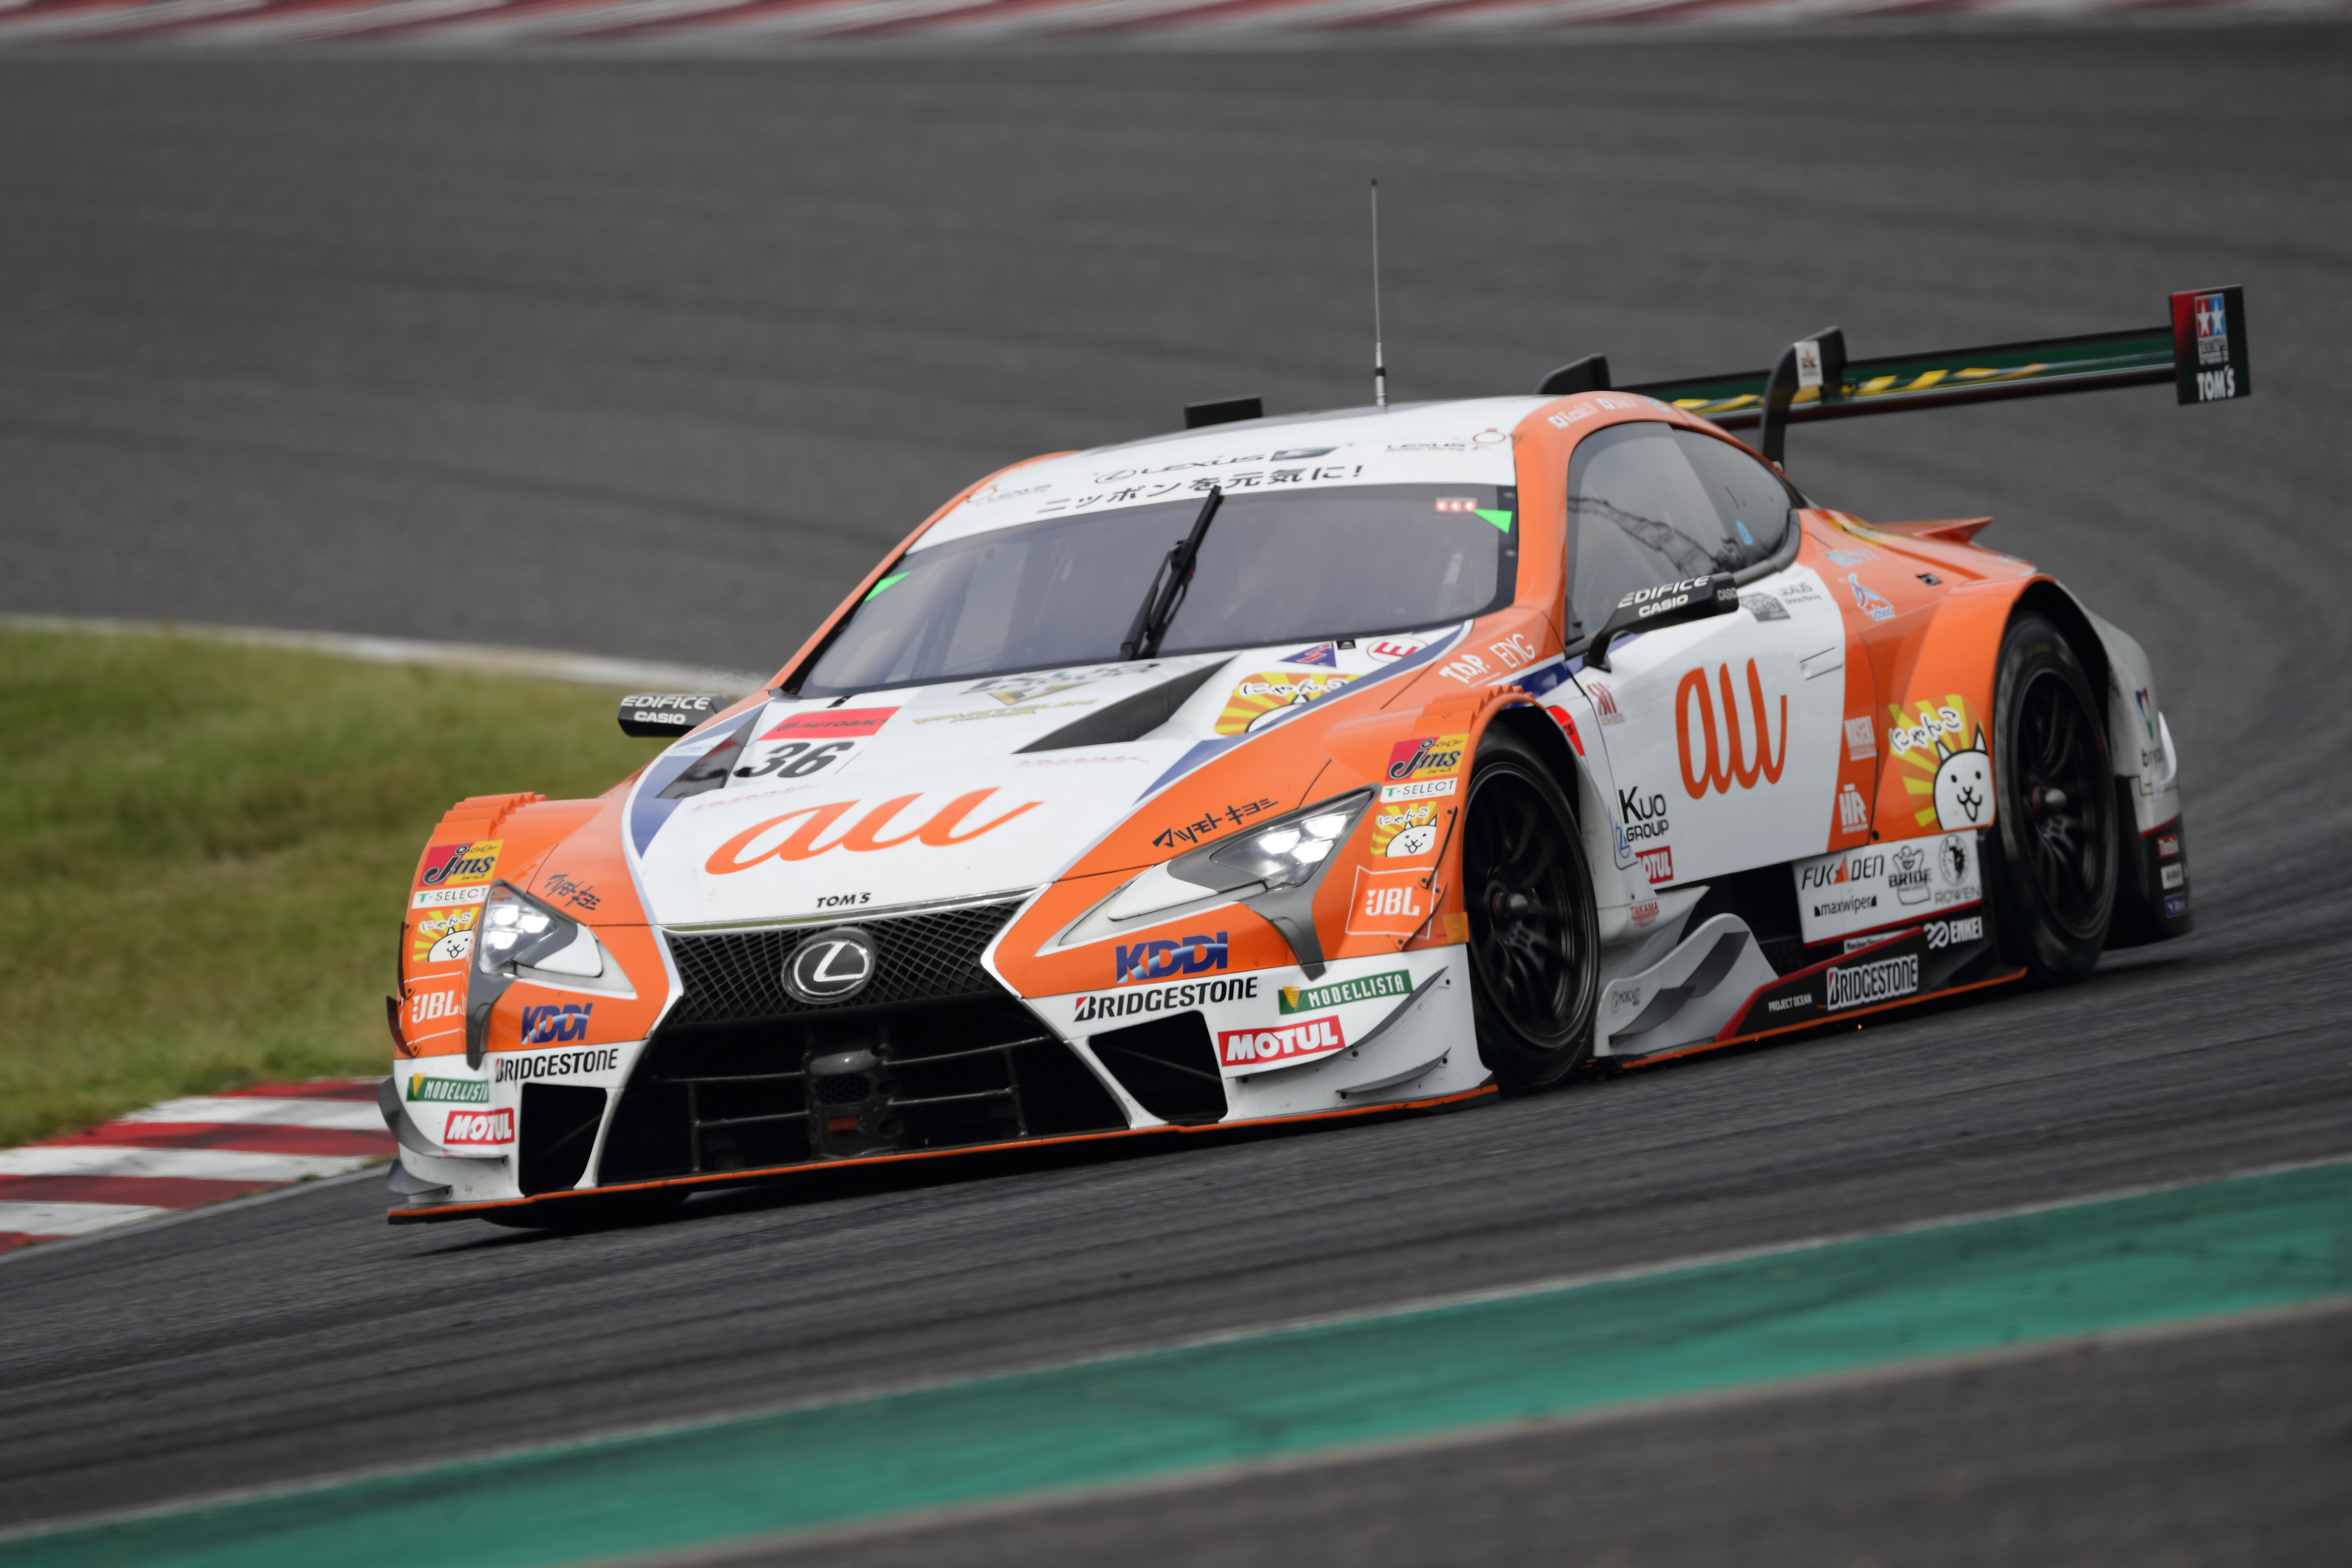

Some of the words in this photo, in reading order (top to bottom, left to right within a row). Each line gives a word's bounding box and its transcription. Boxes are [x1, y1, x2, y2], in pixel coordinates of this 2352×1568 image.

[2197, 365, 2235, 401] TOM'S
[1141, 454, 1266, 474] LEXUS
[1617, 575, 1710, 609] EDIFICE
[1638, 594, 1688, 618] CASIO
[621, 696, 711, 710] EDIFICE
[634, 711, 686, 724] CASIO
[1675, 658, 1787, 799] au
[1889, 707, 1962, 754] にゃんこ
[733, 741, 854, 778] 36
[1386, 780, 1455, 797] T-SELECT
[704, 786, 1045, 875] au
[1378, 808, 1430, 826] にゃんこ
[1626, 819, 1669, 842] GROUP
[1638, 851, 1671, 881] OTUL
[1888, 868, 1932, 888] BRIDE
[418, 888, 487, 903] T-SELECT
[1366, 887, 1420, 916] JBL
[1821, 895, 1871, 916] maxwiper
[420, 913, 472, 931] にゃんこ
[1115, 931, 1228, 983] KDDI
[1308, 974, 1405, 1008] MODELLISTA
[1829, 959, 1917, 1008] BRIDGESTONE
[413, 990, 459, 1023] JBL
[1073, 977, 1258, 1022] BRIDGESTONE
[521, 1002, 593, 1044] KDDI
[1226, 1020, 1338, 1061] MOTUL
[495, 1048, 619, 1083] BRIDGESTONE
[446, 1112, 512, 1141] MOTUL
